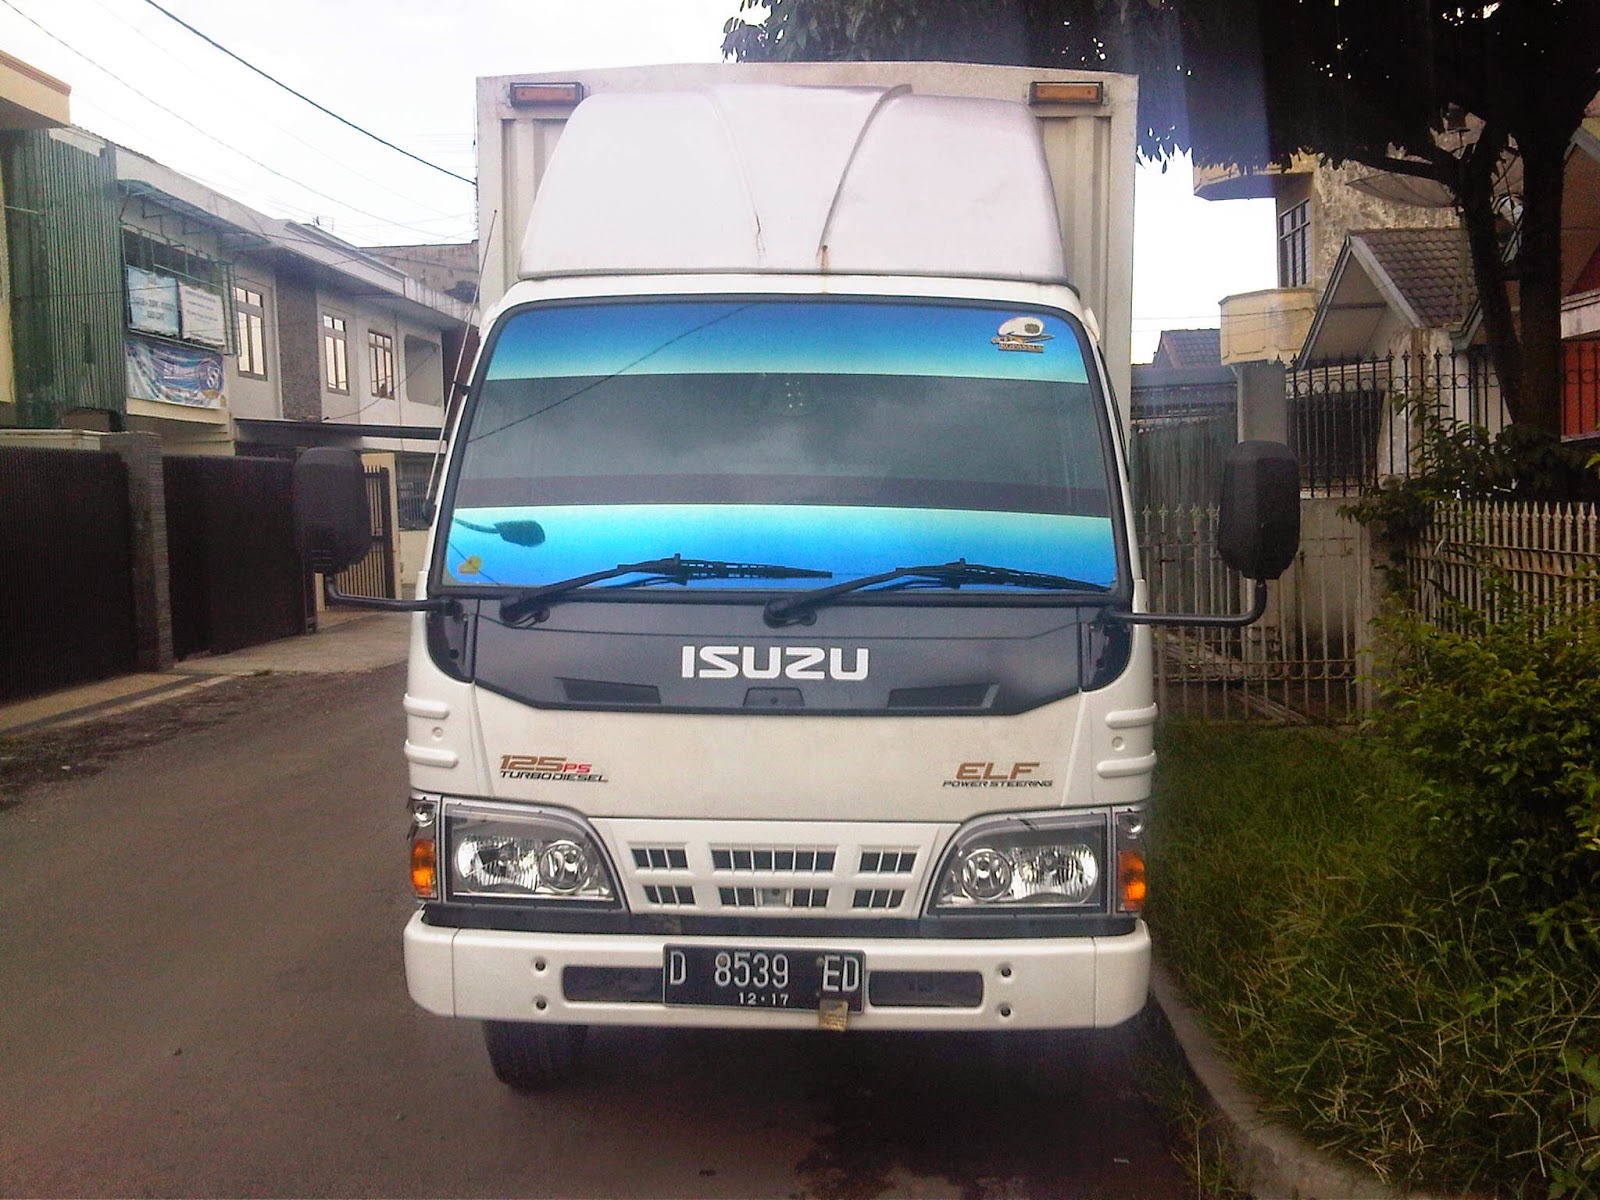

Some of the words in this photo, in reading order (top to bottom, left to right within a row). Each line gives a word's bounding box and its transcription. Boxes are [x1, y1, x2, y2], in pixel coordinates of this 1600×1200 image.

[682, 646, 869, 681] ISUZU
[956, 762, 1040, 779] ELF
[669, 951, 687, 985] D
[714, 952, 789, 989] 8539
[822, 955, 860, 992] ED
